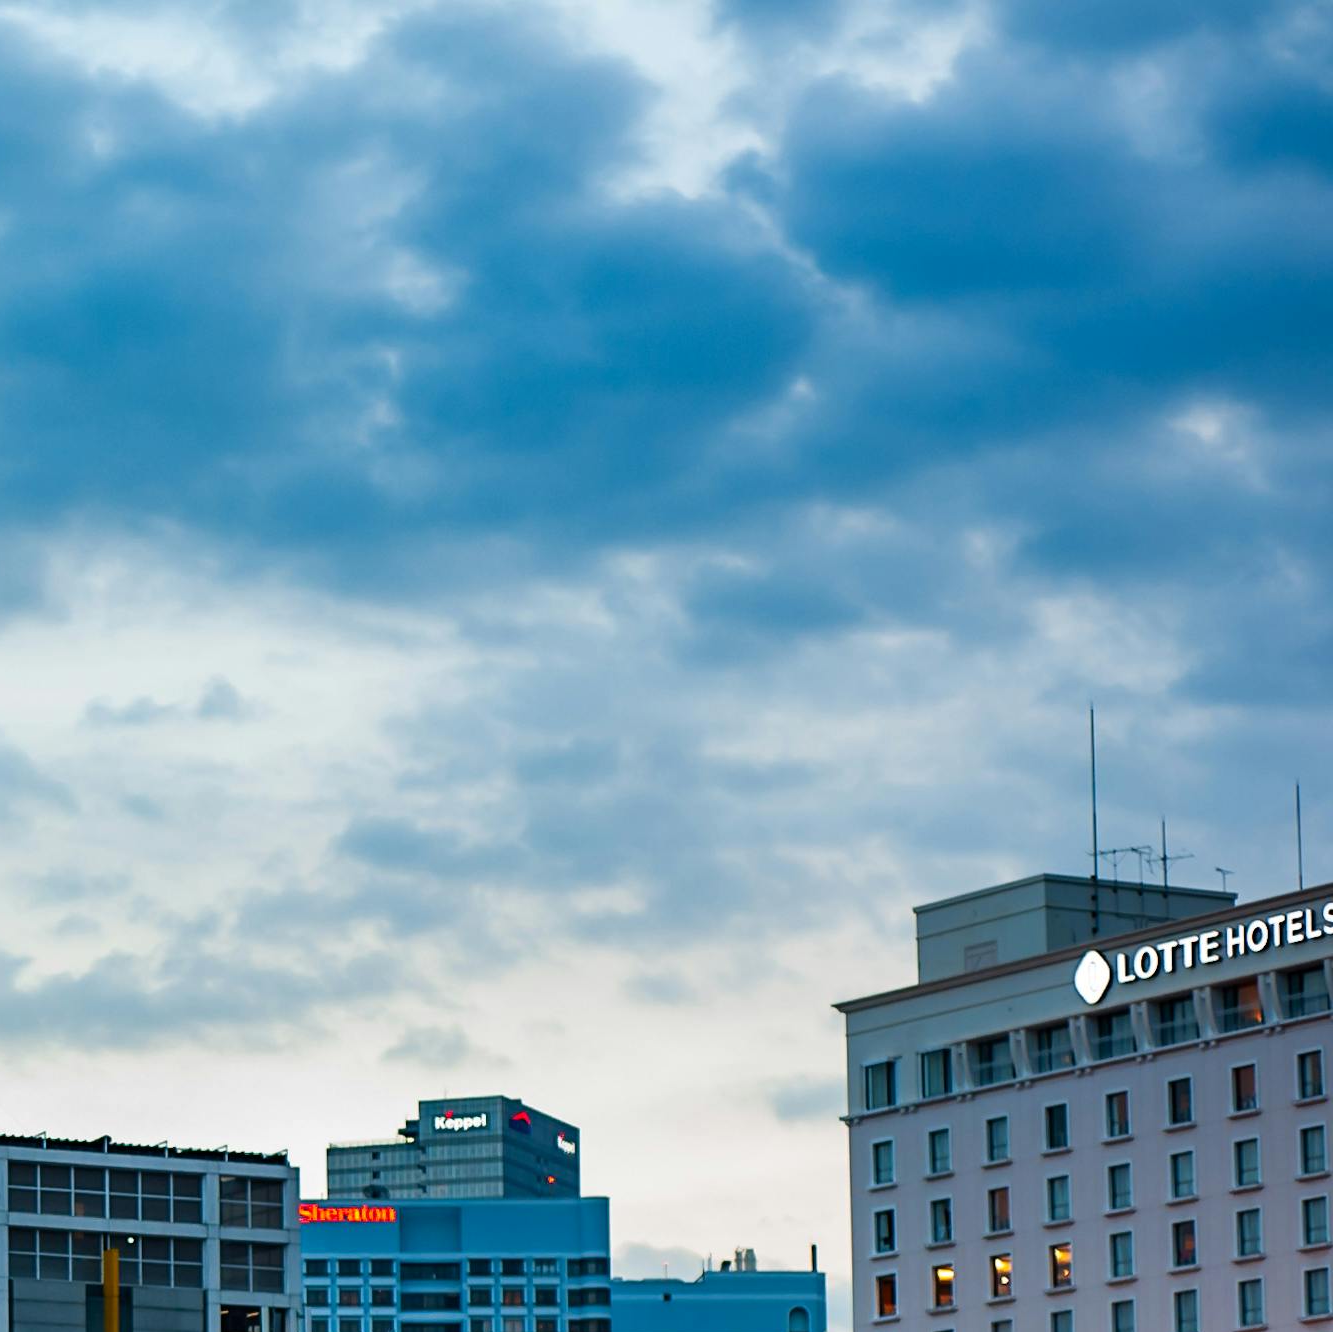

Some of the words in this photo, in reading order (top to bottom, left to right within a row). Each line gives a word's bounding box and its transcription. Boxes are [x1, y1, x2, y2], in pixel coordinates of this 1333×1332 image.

[1116, 930, 1221, 984] LOTTE
[434, 1113, 487, 1131] Keppel
[298, 1203, 396, 1223] Sheraton
